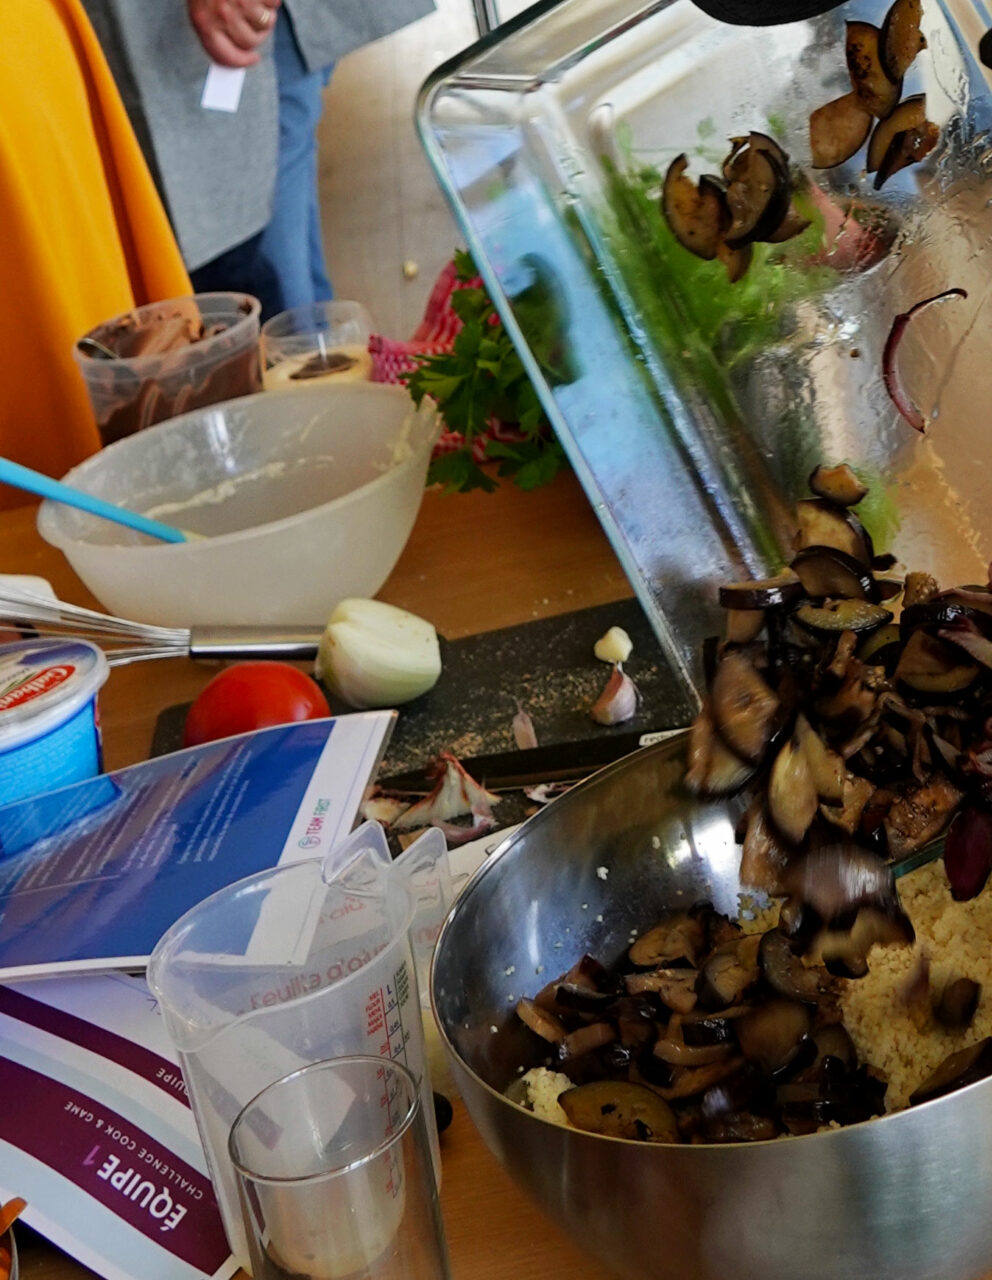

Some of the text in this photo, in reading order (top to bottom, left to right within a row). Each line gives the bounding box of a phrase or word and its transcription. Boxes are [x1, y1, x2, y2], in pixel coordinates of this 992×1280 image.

[305, 816, 325, 836] TEAM
[64, 1101, 203, 1200] CHALLENGE COOK & GAME
[82, 1144, 188, 1232] ÉQUIPE 1
